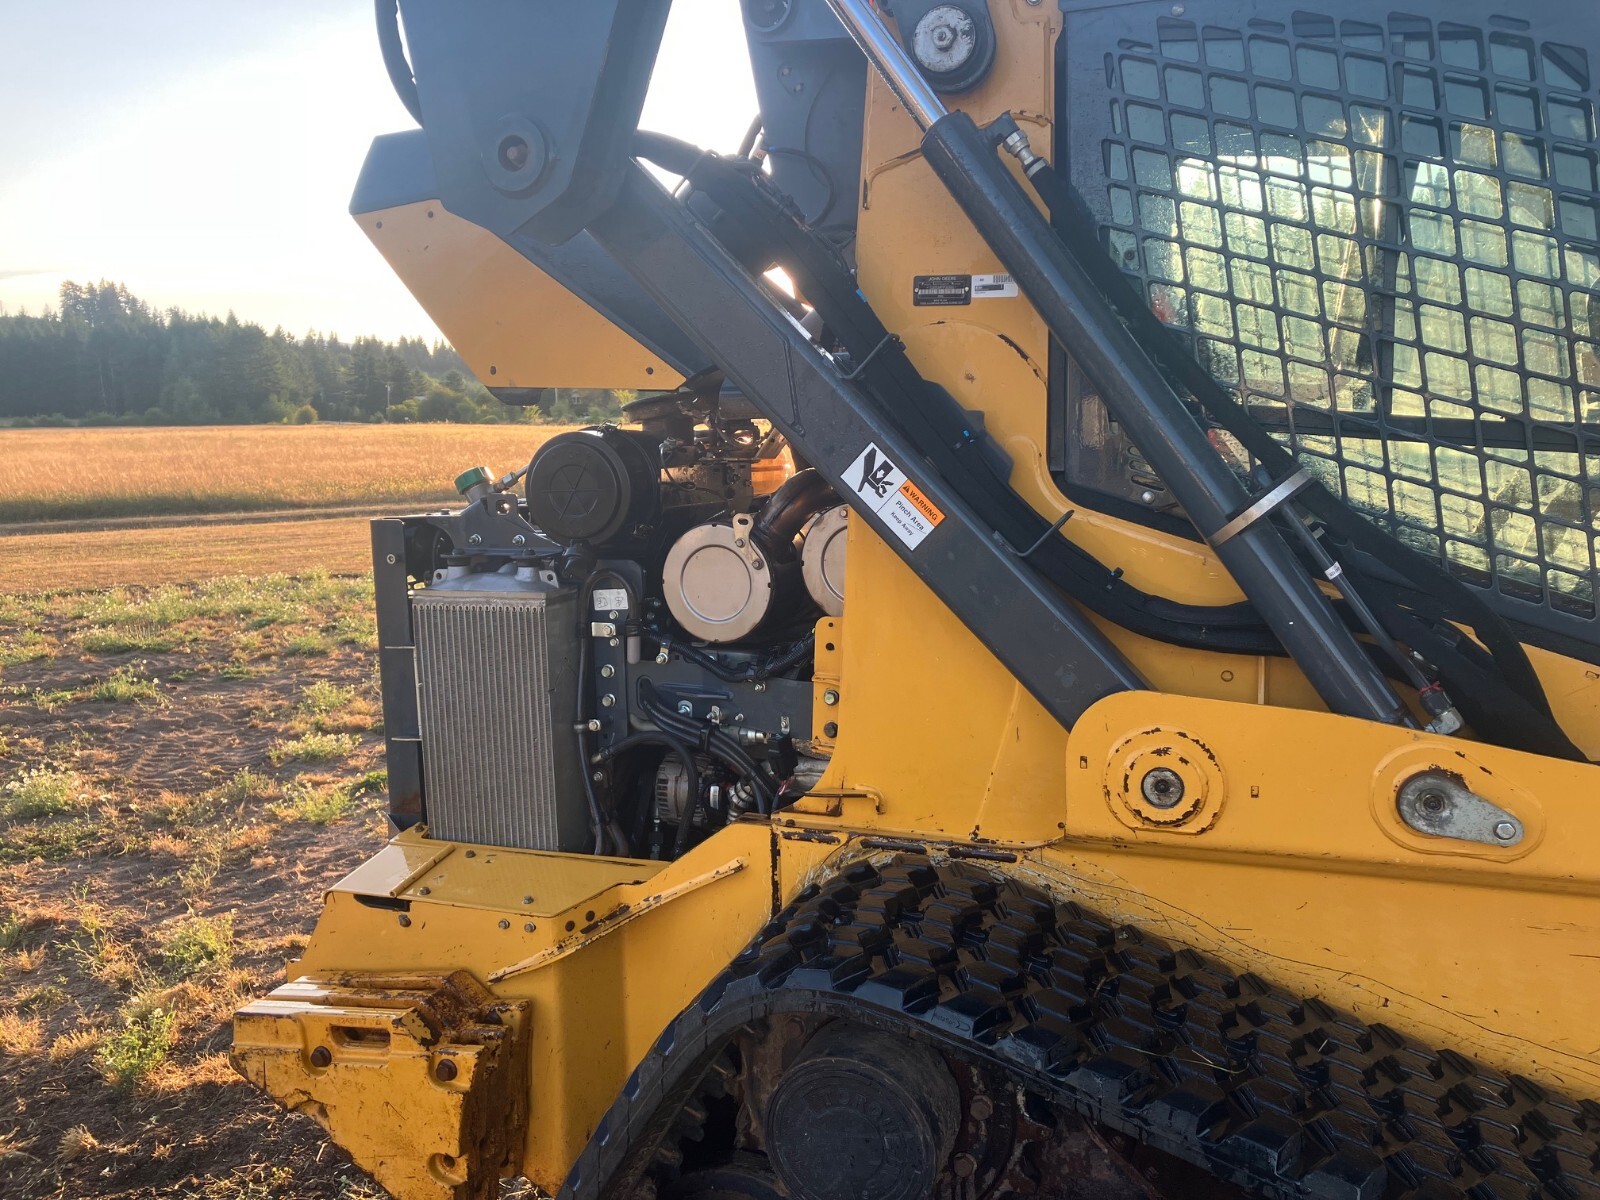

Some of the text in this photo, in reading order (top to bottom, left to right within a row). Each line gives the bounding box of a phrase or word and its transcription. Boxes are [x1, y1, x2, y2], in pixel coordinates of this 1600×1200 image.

[895, 500, 925, 530] Pinch Area
[910, 491, 938, 521] WARNING
[890, 511, 914, 536] Keep Away
